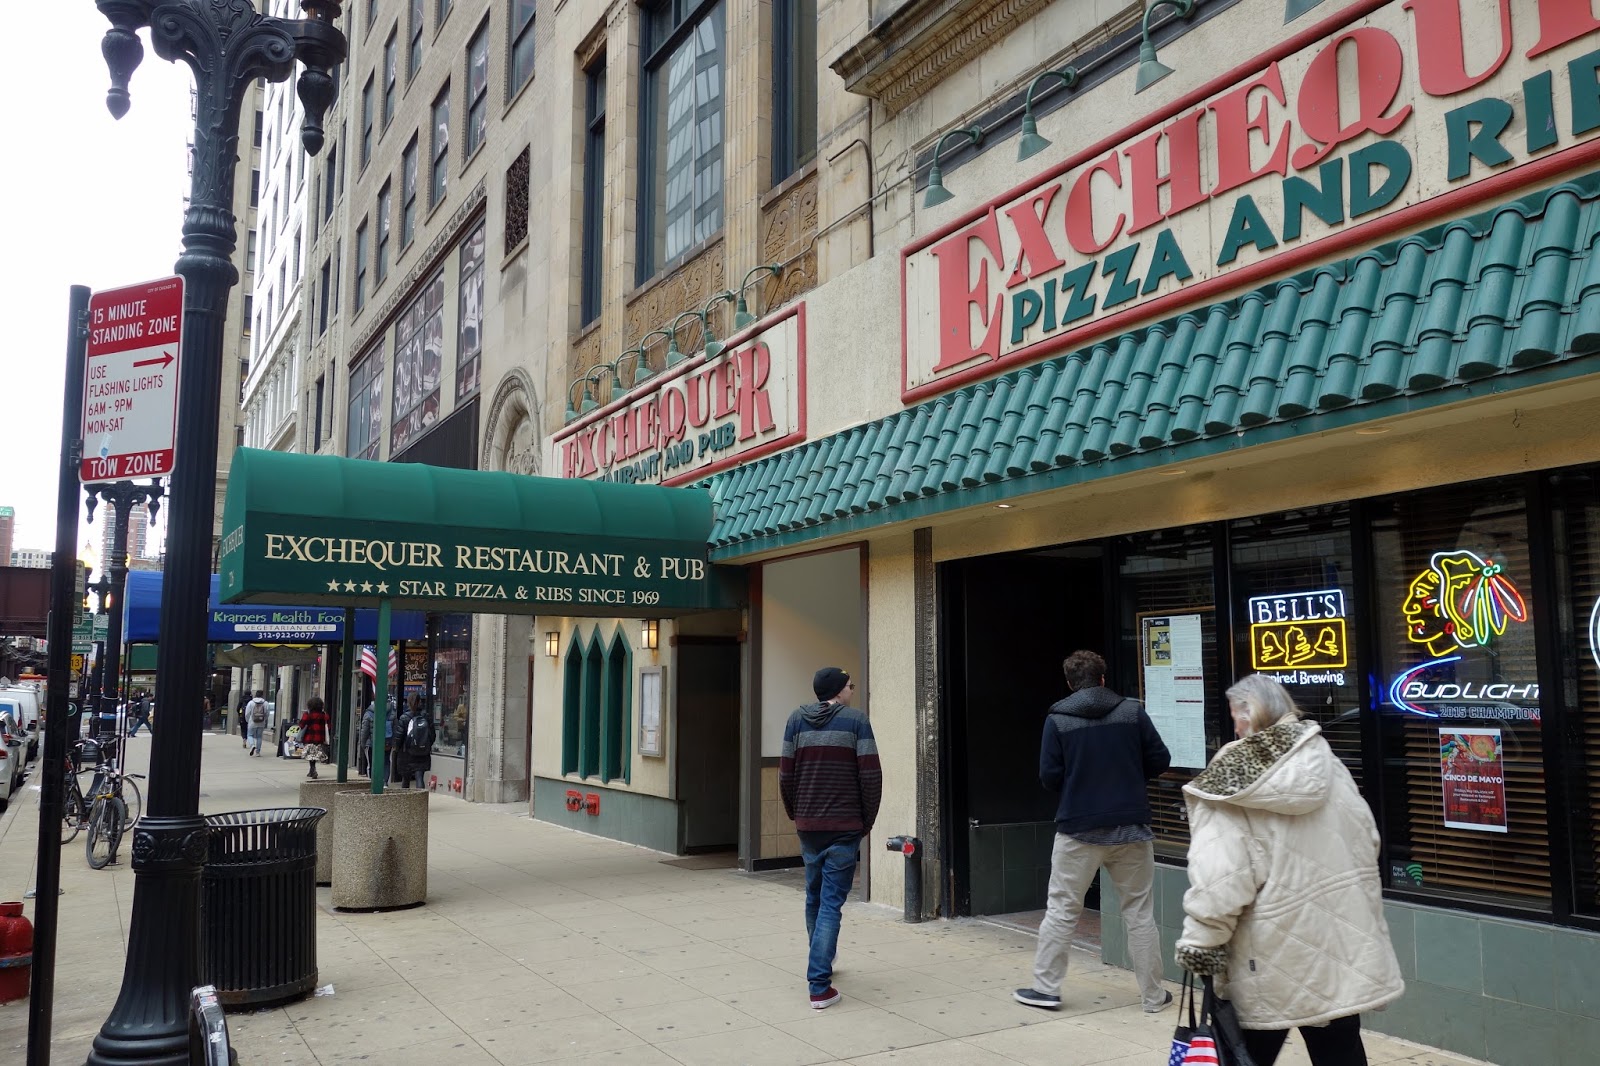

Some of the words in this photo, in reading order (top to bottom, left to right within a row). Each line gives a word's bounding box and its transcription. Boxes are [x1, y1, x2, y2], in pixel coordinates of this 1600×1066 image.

[1010, 228, 1192, 345] PIZZA
[1216, 140, 1412, 267] AND
[93, 309, 104, 324] 15
[108, 300, 147, 322] MINUTE
[92, 323, 143, 345] STANDING
[148, 315, 177, 335] ZONE
[90, 365, 107, 380] USE
[89, 380, 130, 398] FLASHING
[133, 375, 163, 392] LIGHTS
[88, 402, 106, 416] 6AM
[114, 398, 133, 412] 9PM
[562, 341, 776, 478] EXCHEQUER
[87, 417, 124, 434] MON-SAT
[664, 439, 694, 471] AND
[697, 421, 736, 458] PUB
[91, 459, 118, 478] TOW
[124, 453, 163, 475] ZONE
[265, 533, 443, 571] EXCHEQUER
[455, 545, 624, 577] RESTAURANT
[633, 556, 651, 579] &
[660, 556, 705, 580] PUB
[399, 580, 447, 597] STAR
[454, 582, 507, 599] PIZZA
[514, 585, 528, 600] &
[535, 586, 572, 602] RIBS
[578, 588, 625, 604] SINCE
[631, 590, 660, 605] 1969
[213, 611, 267, 623] Kramers
[1256, 594, 1337, 623] BELL'S
[258, 632, 316, 640] 312-922-0077
[1300, 671, 1345, 686] Brewing
[1403, 682, 1461, 698] BUD
[1440, 706, 1467, 718] 2015
[1444, 774, 1467, 782] CINCO
[1467, 775, 1479, 783] DE
[1479, 776, 1502, 784] MAYO
